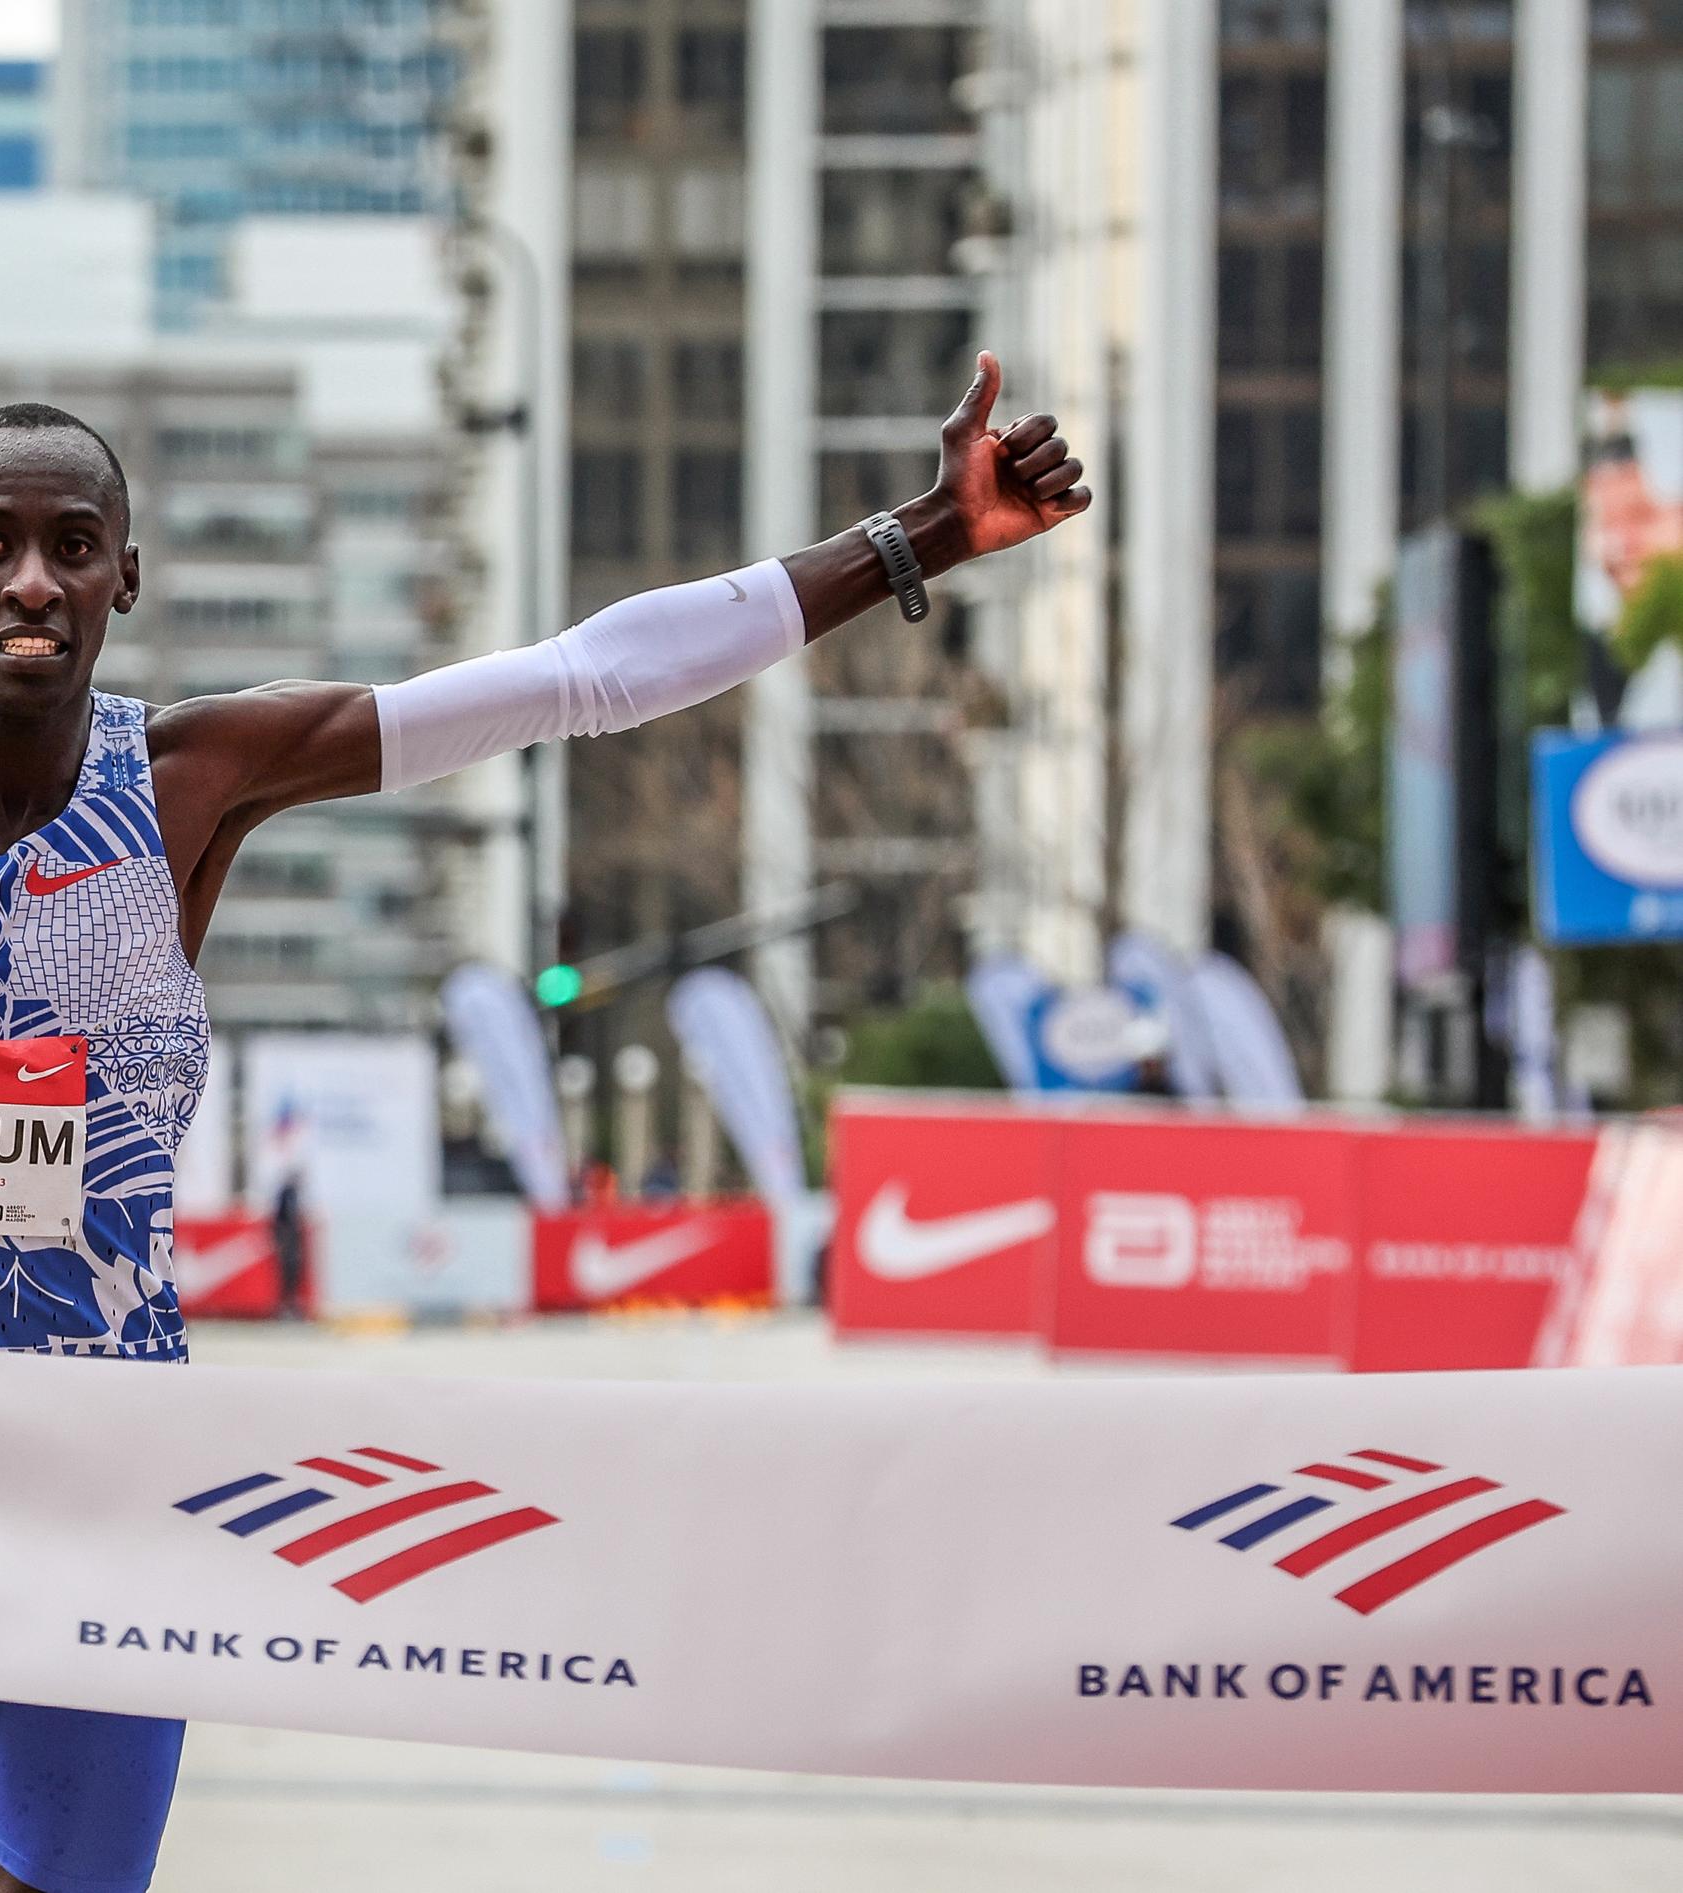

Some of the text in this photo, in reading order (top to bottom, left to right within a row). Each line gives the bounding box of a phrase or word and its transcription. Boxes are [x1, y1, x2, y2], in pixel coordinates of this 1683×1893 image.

[78, 1620, 638, 1688] BANK OF AMERICA
[1077, 1662, 1656, 1708] BANK OF AMERICA
